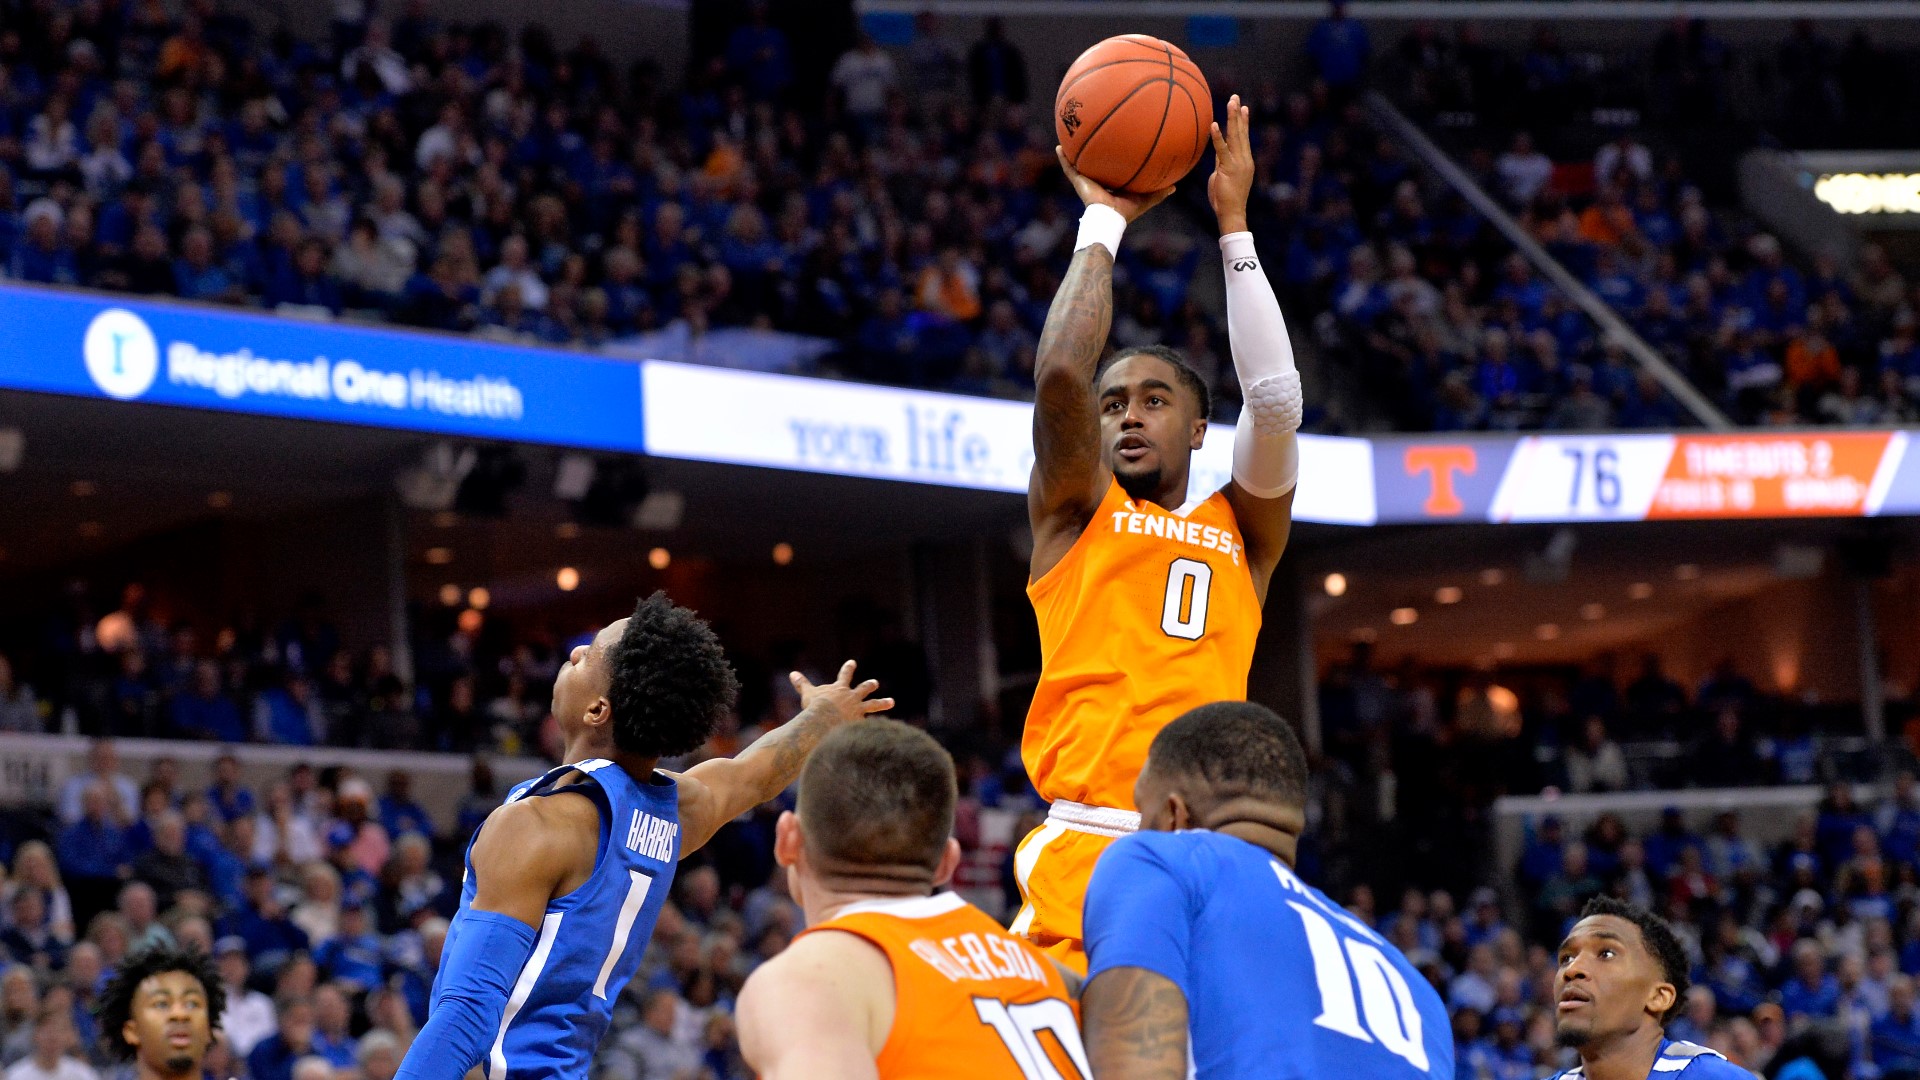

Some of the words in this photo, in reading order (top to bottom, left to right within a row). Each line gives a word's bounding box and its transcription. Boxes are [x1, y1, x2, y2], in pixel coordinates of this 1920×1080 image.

[168, 341, 330, 399] Regional
[332, 360, 407, 409] One
[409, 368, 524, 420] Health
[789, 418, 889, 465] YOUR
[1404, 445, 1476, 516] T
[1562, 449, 1622, 508] 76
[1160, 556, 1213, 642] 0
[626, 808, 678, 863] HARRIS
[592, 869, 653, 1001] 1
[1285, 899, 1430, 1072] 10
[969, 993, 1097, 1080] 10
